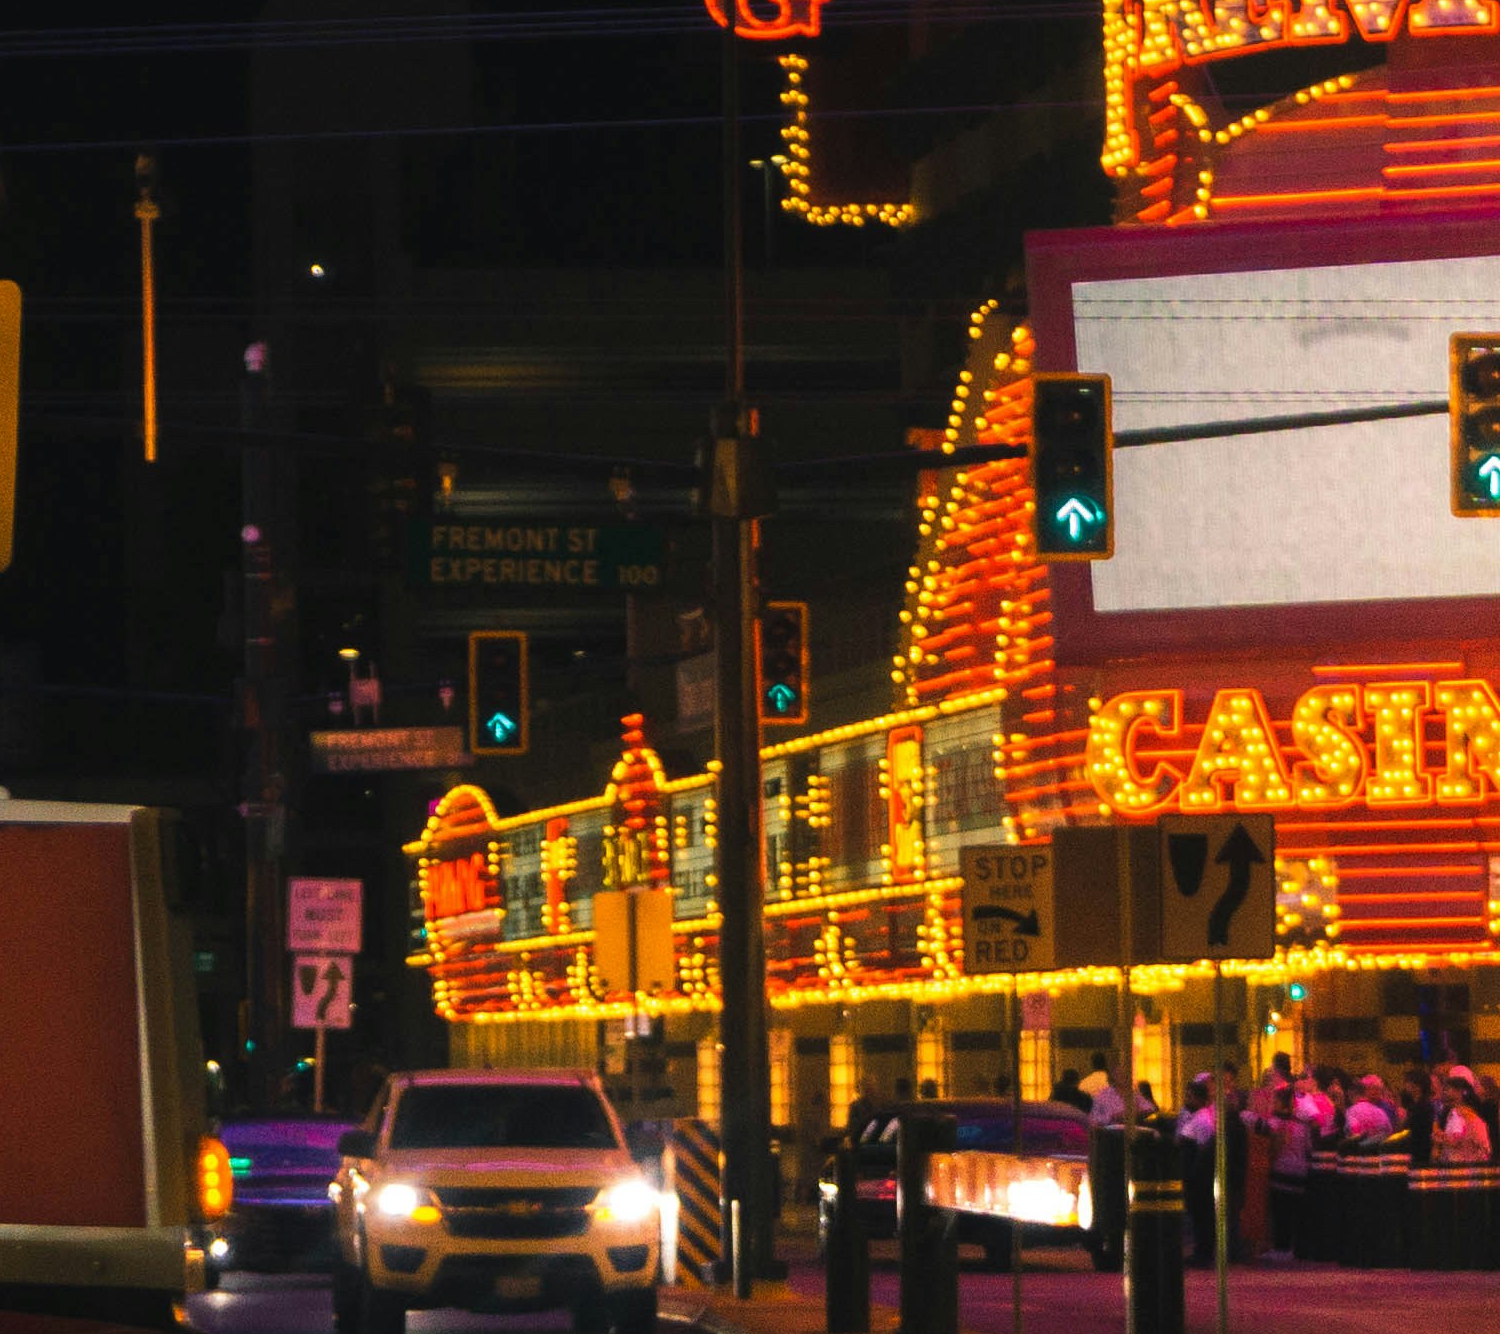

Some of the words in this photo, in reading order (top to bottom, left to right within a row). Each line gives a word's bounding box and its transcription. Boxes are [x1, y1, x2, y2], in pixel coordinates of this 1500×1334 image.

[430, 524, 560, 552] FREMONT
[567, 526, 598, 553] ST
[430, 556, 601, 585] EXPERIENCE
[975, 854, 1048, 881] STOP
[989, 884, 1033, 900] HERE
[975, 938, 1029, 964] RED
